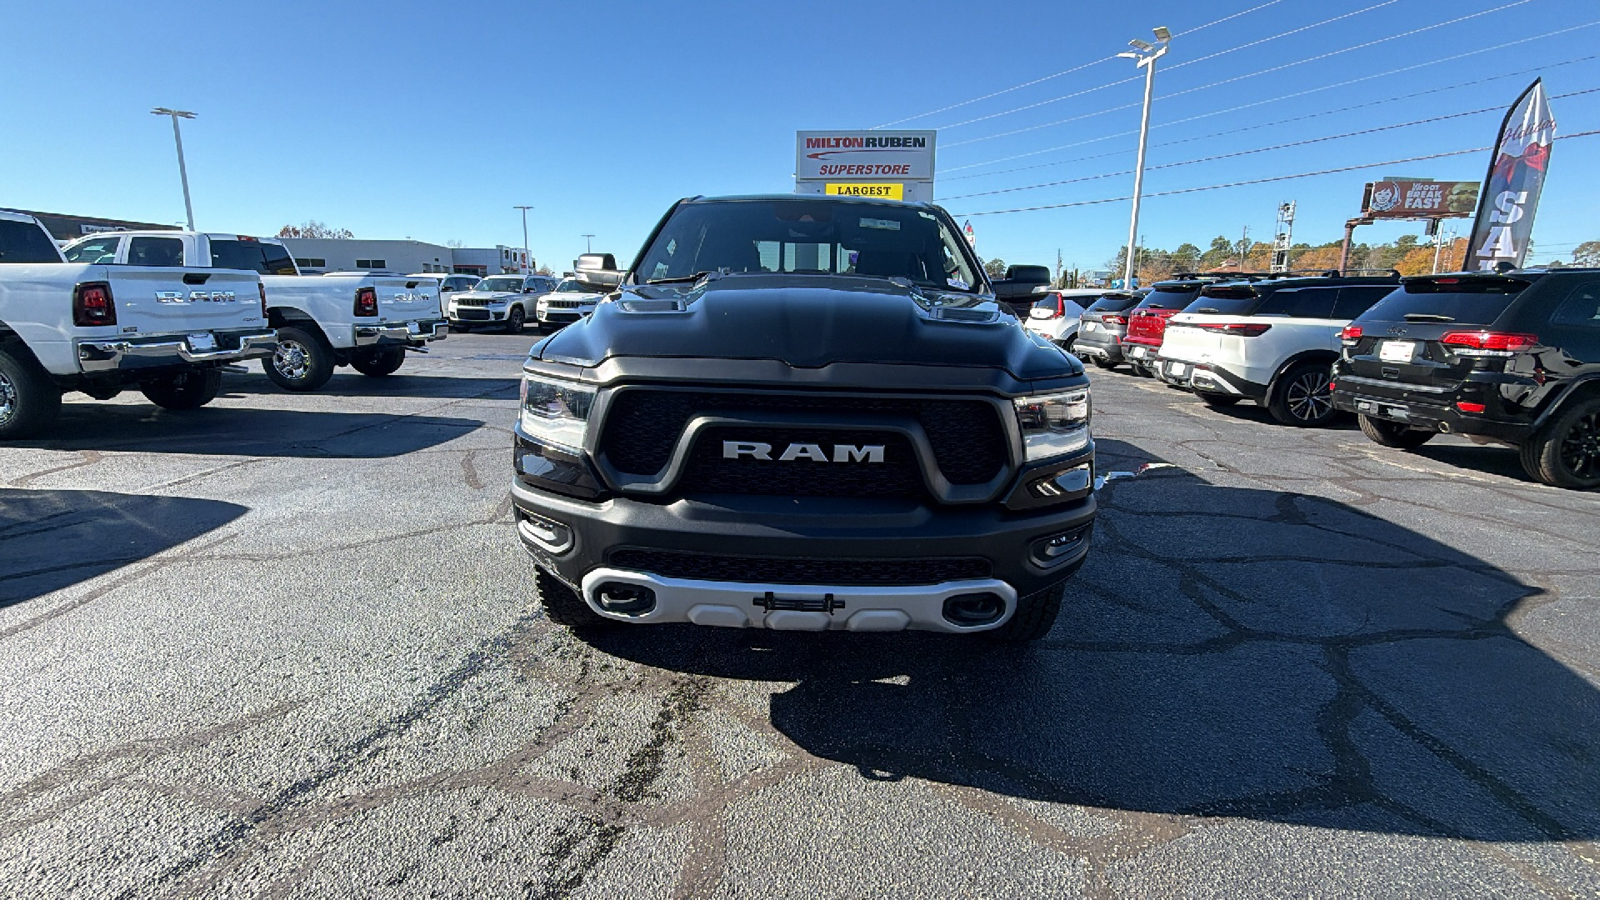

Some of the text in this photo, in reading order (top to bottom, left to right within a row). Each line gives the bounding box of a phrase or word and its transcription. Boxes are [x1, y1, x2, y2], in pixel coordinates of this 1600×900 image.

[819, 164, 911, 175] SUPERSTORE
[837, 186, 892, 196] LARGEST
[1406, 190, 1443, 198] BREAK
[1404, 198, 1442, 209] FAST
[155, 290, 236, 303] RAM
[722, 440, 887, 464] RAM
